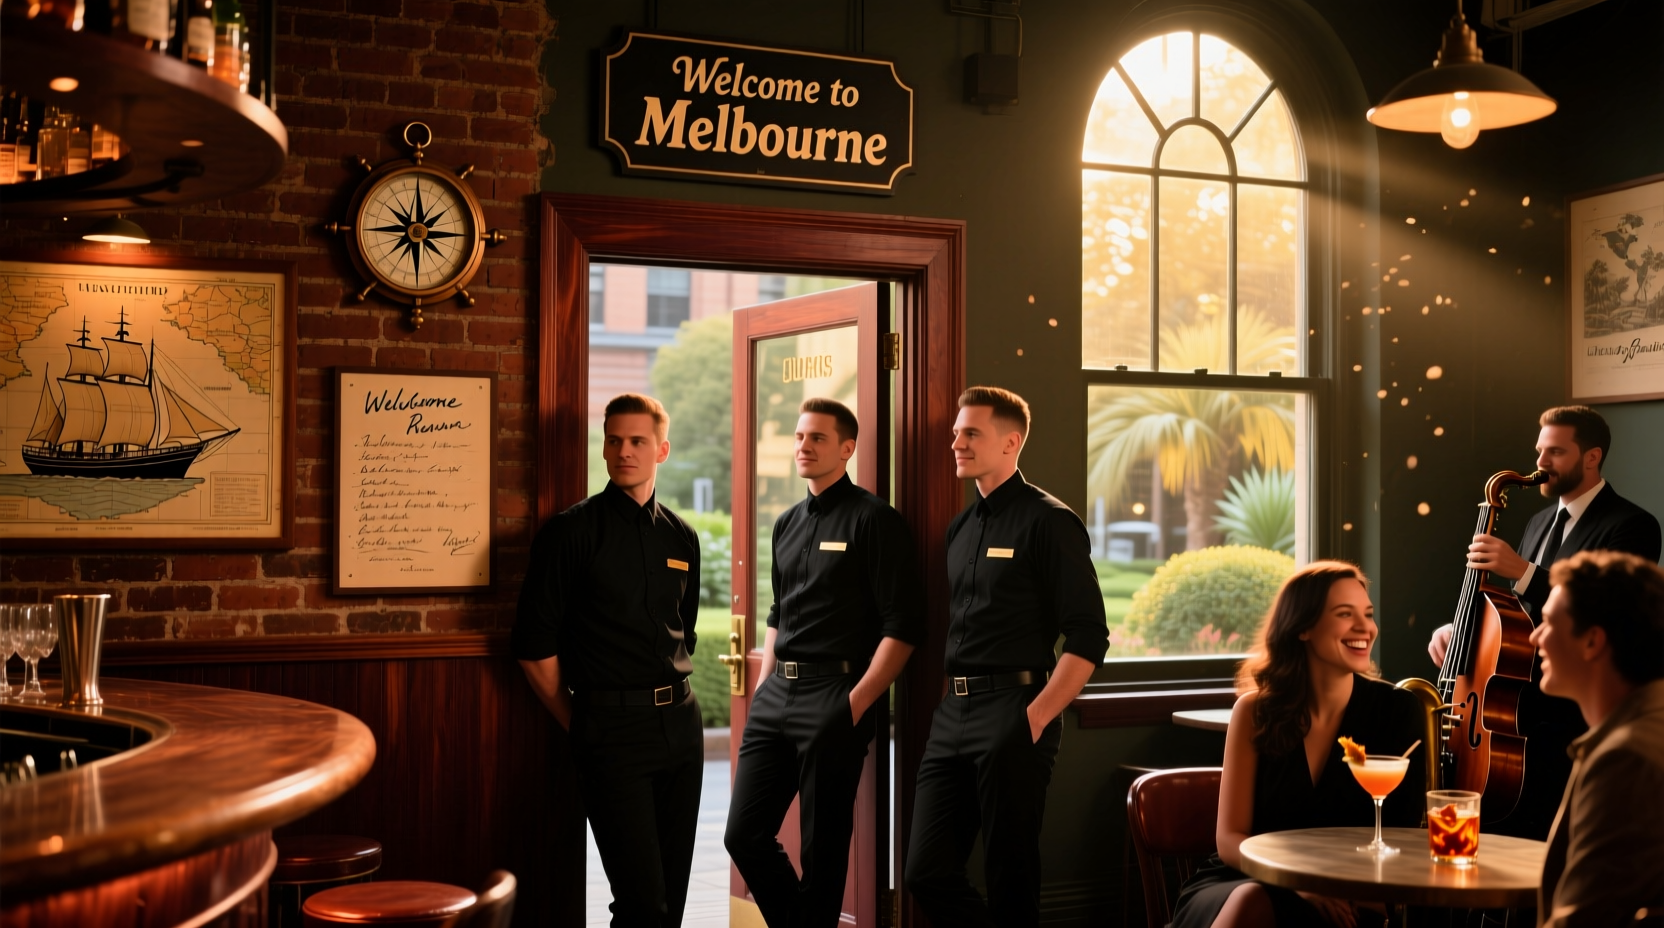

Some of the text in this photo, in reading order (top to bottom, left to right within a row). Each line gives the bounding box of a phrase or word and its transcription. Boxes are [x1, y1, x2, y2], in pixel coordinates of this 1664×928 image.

[672, 55, 860, 107] Welcome to
[634, 96, 887, 166] Melbourne
